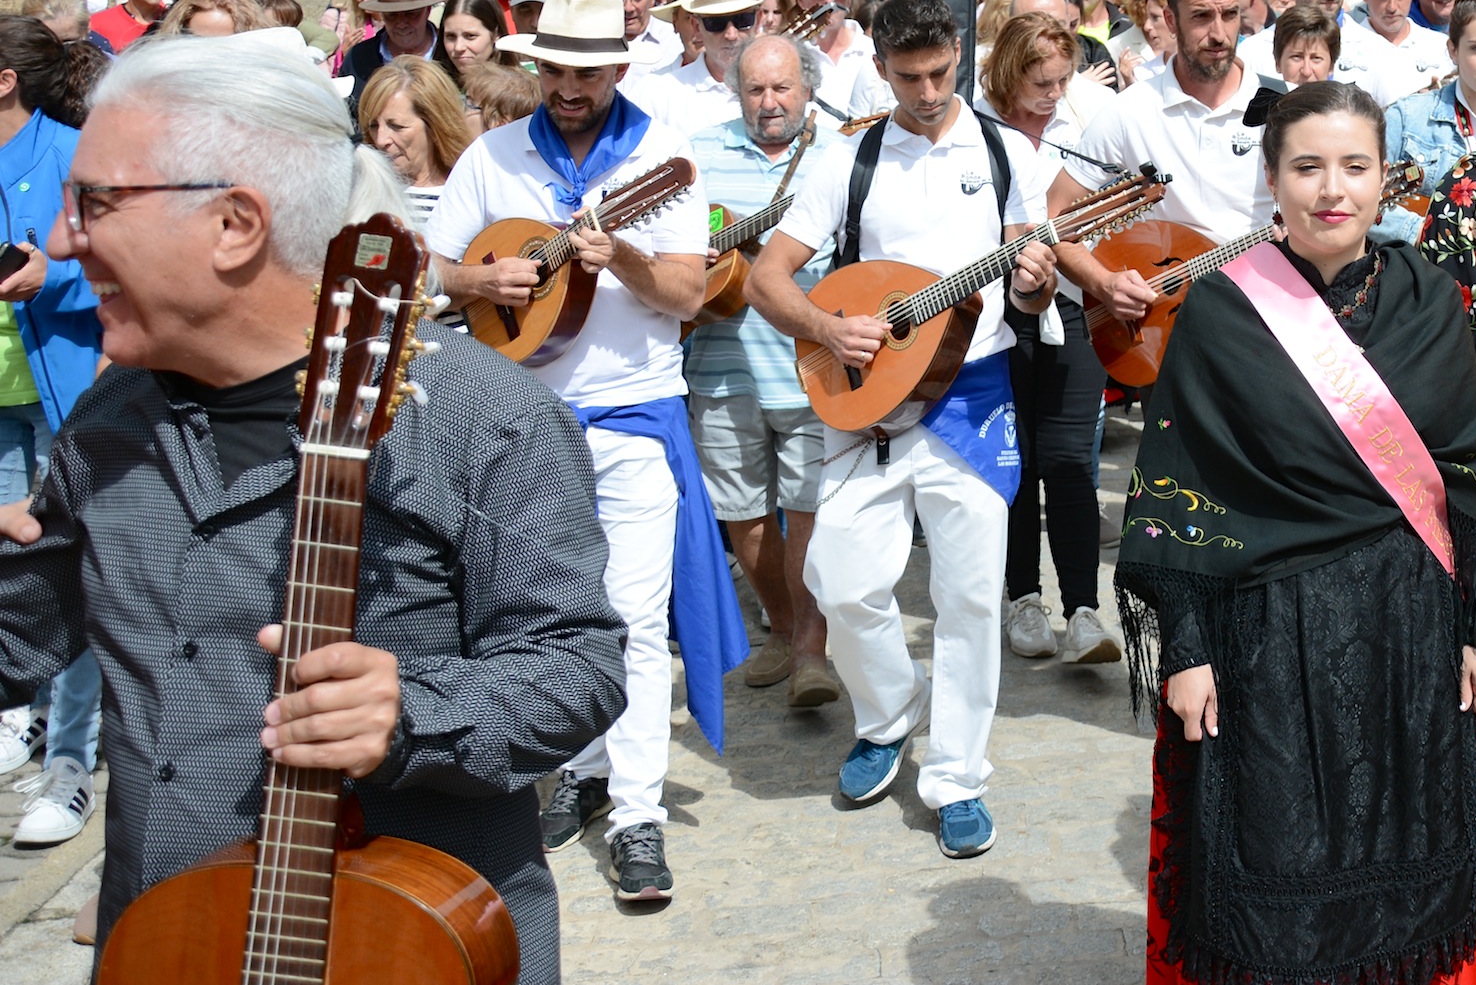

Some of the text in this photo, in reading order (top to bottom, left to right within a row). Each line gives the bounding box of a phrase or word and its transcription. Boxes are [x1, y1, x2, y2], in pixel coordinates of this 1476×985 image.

[1313, 346, 1375, 426] DAMA
[1369, 427, 1405, 464] DE
[1394, 463, 1429, 511] LAS
